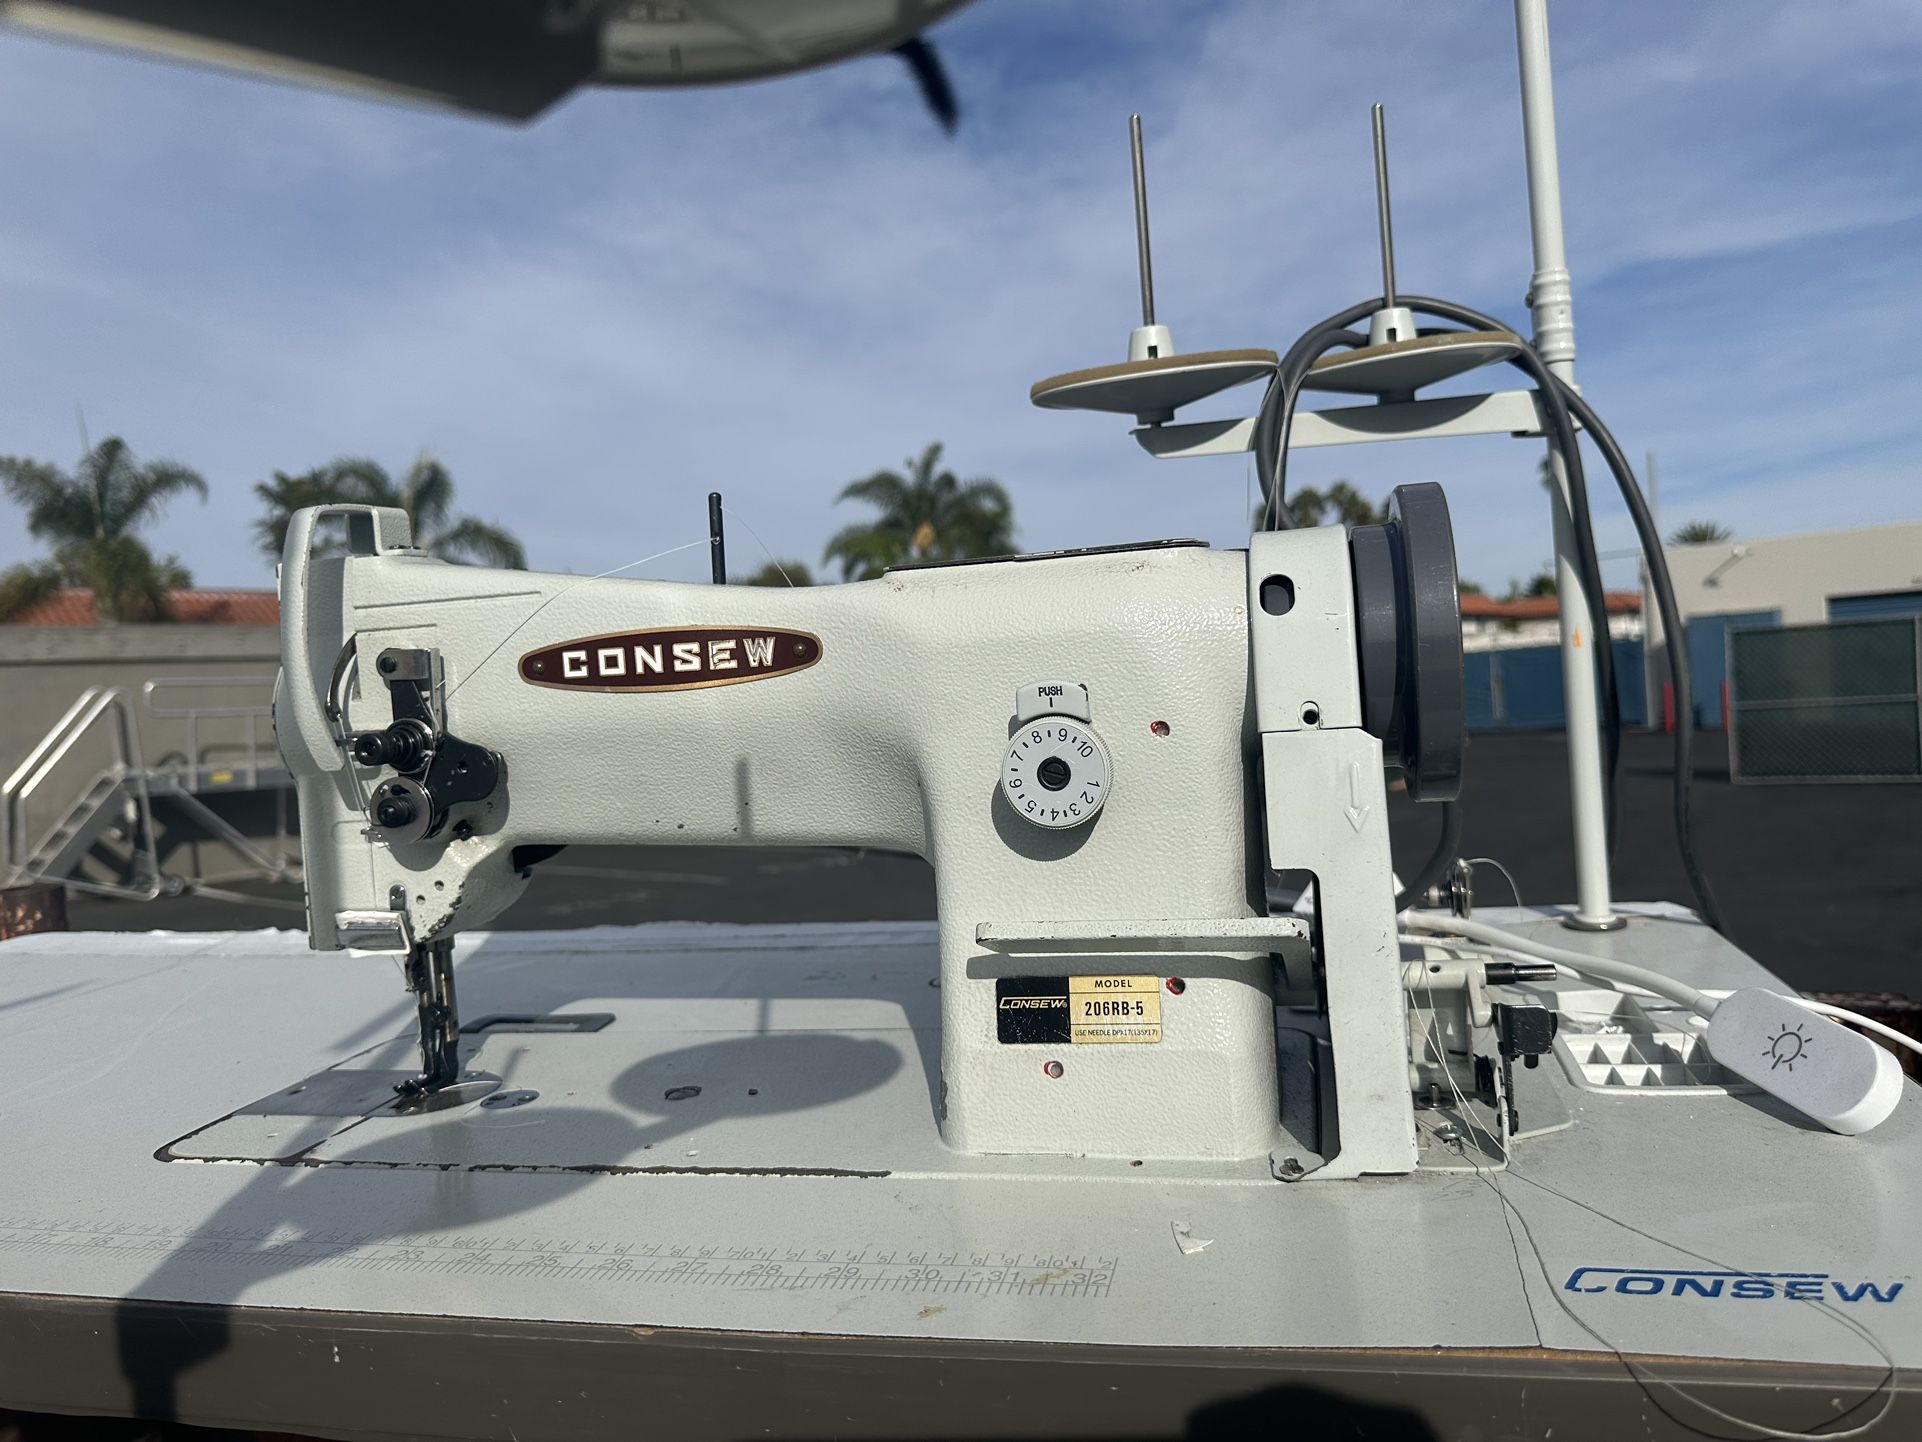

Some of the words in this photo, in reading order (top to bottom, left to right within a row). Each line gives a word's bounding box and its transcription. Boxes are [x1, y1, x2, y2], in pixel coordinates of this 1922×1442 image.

[562, 637, 776, 679] CONSEW
[1038, 686, 1063, 697] PUSH
[1031, 730, 1043, 744] 8
[1058, 728, 1068, 742] 9
[1010, 750, 1024, 762] 7
[1077, 740, 1093, 758] 10
[1009, 778, 1023, 789] 6
[1080, 791, 1094, 804] 2
[1024, 800, 1037, 814] 5
[1069, 803, 1081, 816] 3
[1050, 808, 1060, 822] 4
[1094, 980, 1132, 988] MODEL
[999, 996, 1068, 1009] CONSEW
[1085, 1001, 1144, 1016] 206RB-5
[1074, 1029, 1086, 1037] USE
[1088, 1029, 1110, 1037] NEEDLE
[746, 1263, 782, 1275] 28
[824, 1266, 860, 1278] 29
[905, 1268, 940, 1280] 30
[1071, 1272, 1108, 1284] 32
[1564, 1267, 1904, 1303] CONSEW
